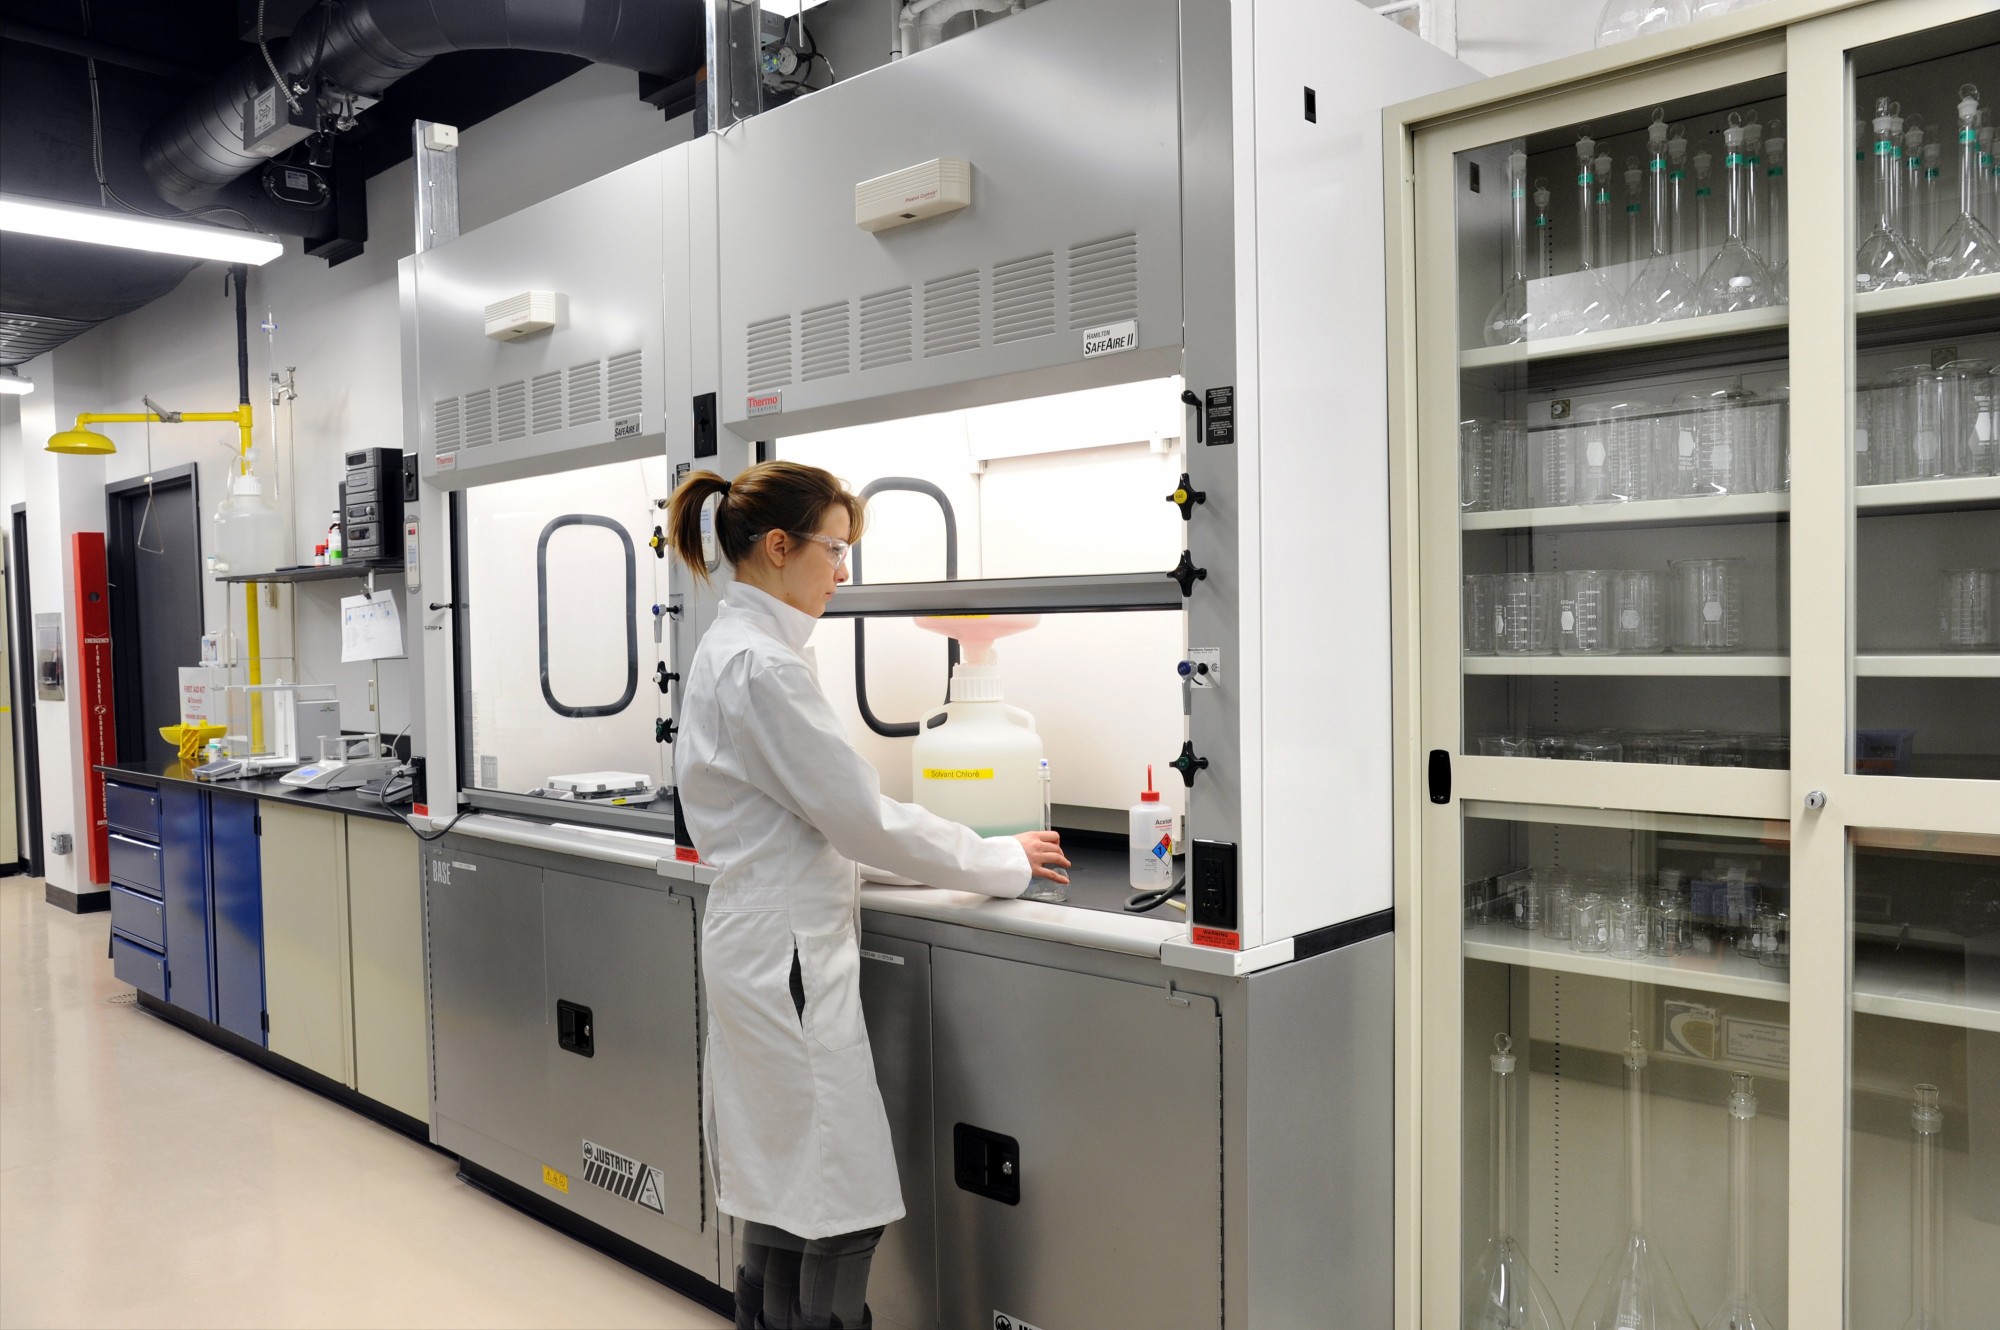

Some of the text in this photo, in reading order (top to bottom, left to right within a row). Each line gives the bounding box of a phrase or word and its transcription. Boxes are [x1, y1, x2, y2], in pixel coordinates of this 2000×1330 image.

[1086, 329, 1111, 340] HAMILTON
[1127, 333, 1134, 346] II
[747, 396, 778, 409] Thermo
[436, 455, 454, 465] Thermo
[931, 769, 980, 778] Solvant Chloré
[432, 860, 451, 885] BASE
[1203, 929, 1229, 938] WARNING
[594, 1147, 634, 1176] JUSTRITE
